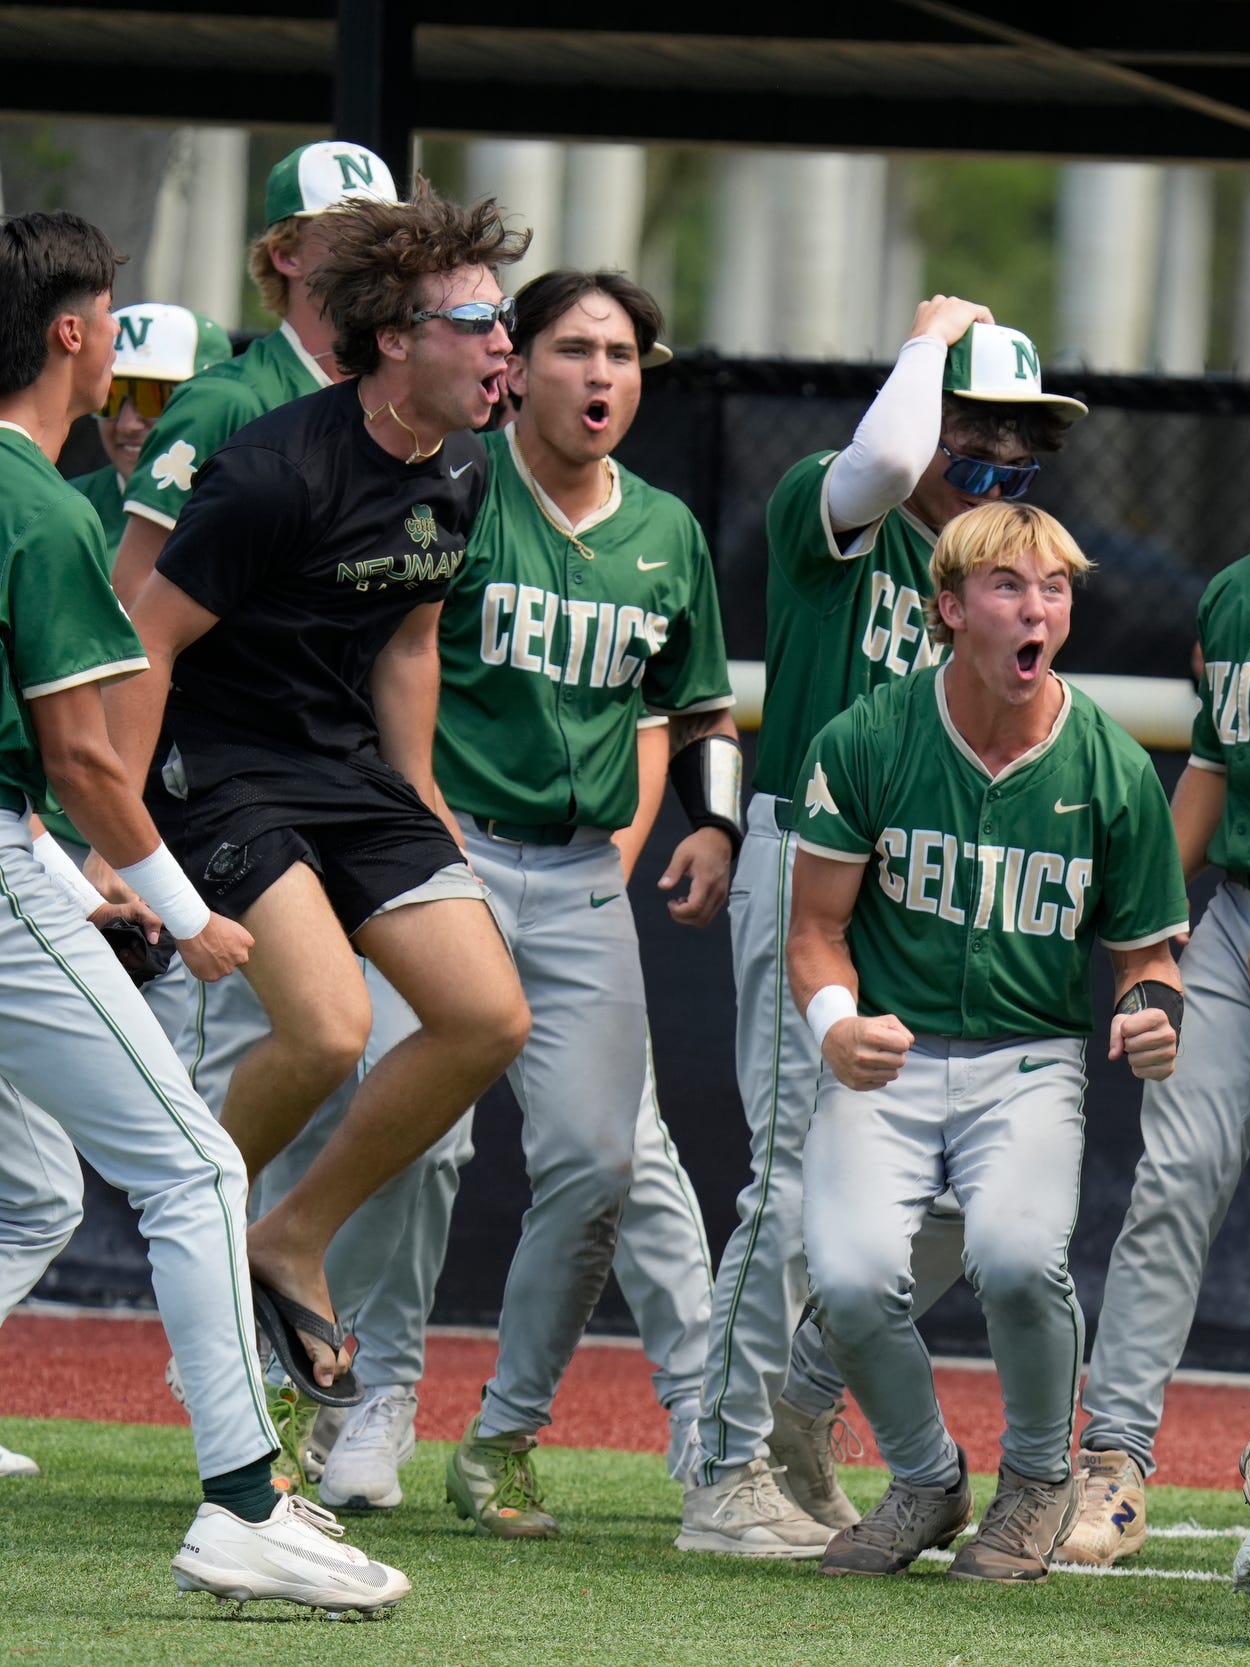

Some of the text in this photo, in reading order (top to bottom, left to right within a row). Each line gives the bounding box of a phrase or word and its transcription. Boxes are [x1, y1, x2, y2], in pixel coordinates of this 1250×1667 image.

[333, 154, 374, 189] N
[114, 317, 153, 350] N
[1014, 340, 1038, 380] N
[875, 827, 1093, 941] CELTICS
